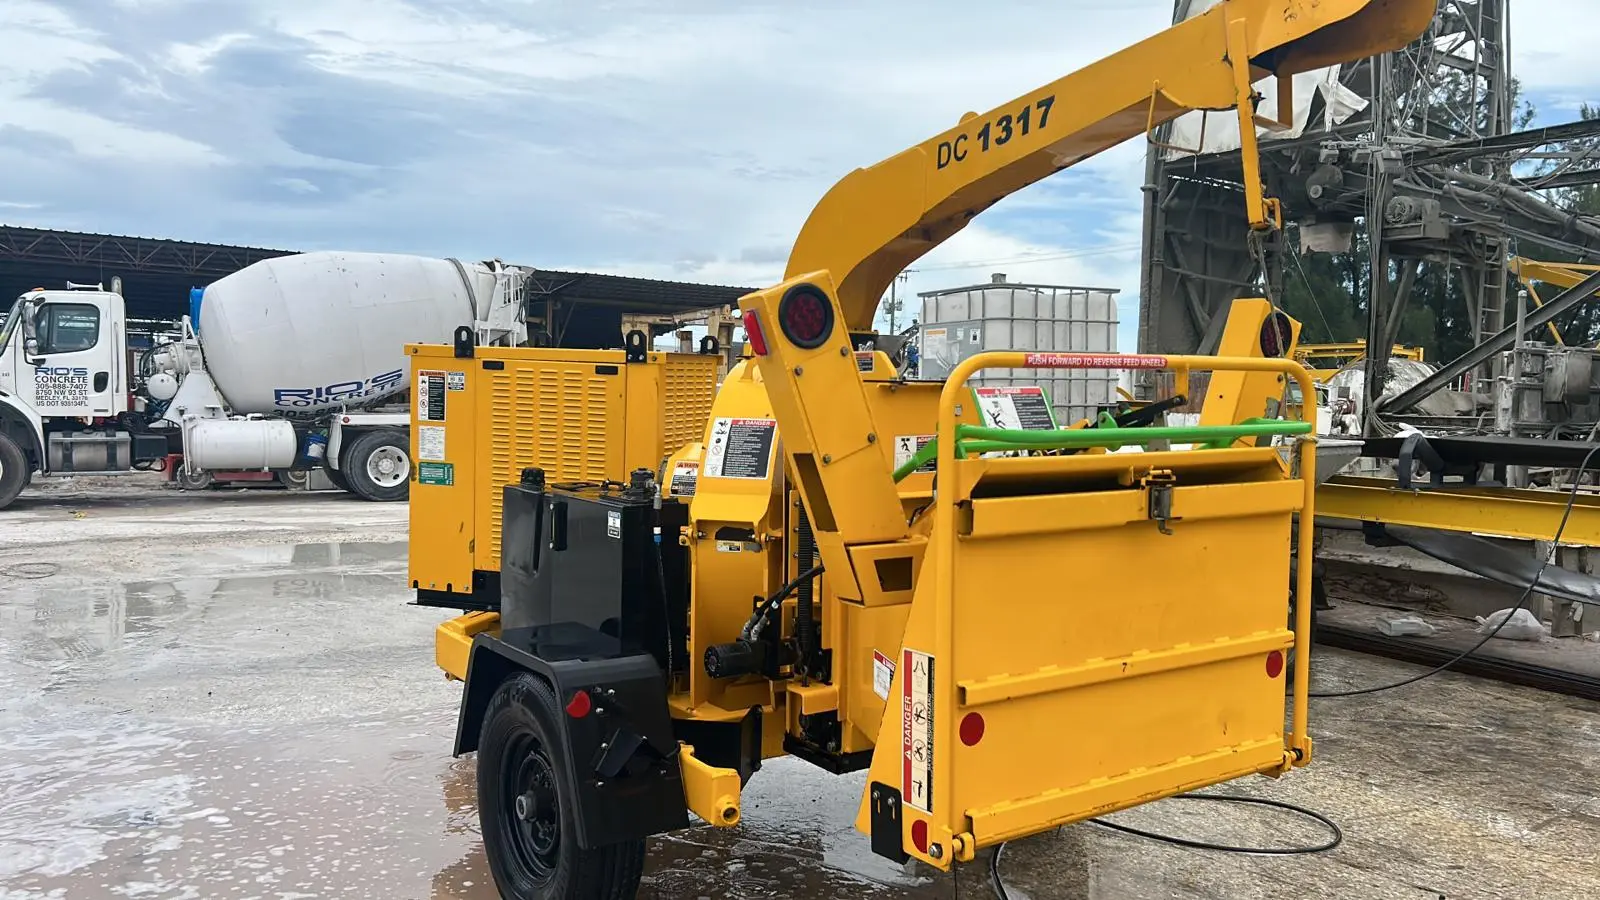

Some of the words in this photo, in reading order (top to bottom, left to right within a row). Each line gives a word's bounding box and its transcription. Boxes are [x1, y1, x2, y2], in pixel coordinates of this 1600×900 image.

[937, 133, 968, 170] DC
[977, 94, 1055, 152] 1317
[34, 367, 88, 376] RIO'S
[1028, 354, 1047, 365] PUSH
[1049, 356, 1081, 366] FORWARD
[1083, 357, 1093, 366] TO
[1094, 357, 1122, 366] REVERSE
[1123, 358, 1140, 366] FEED
[1141, 358, 1166, 367] WHEELS
[34, 376, 88, 384] CONCRETE
[274, 369, 403, 401] RIO'S
[274, 381, 401, 407] CONCRETE
[904, 695, 912, 746] DANGER
